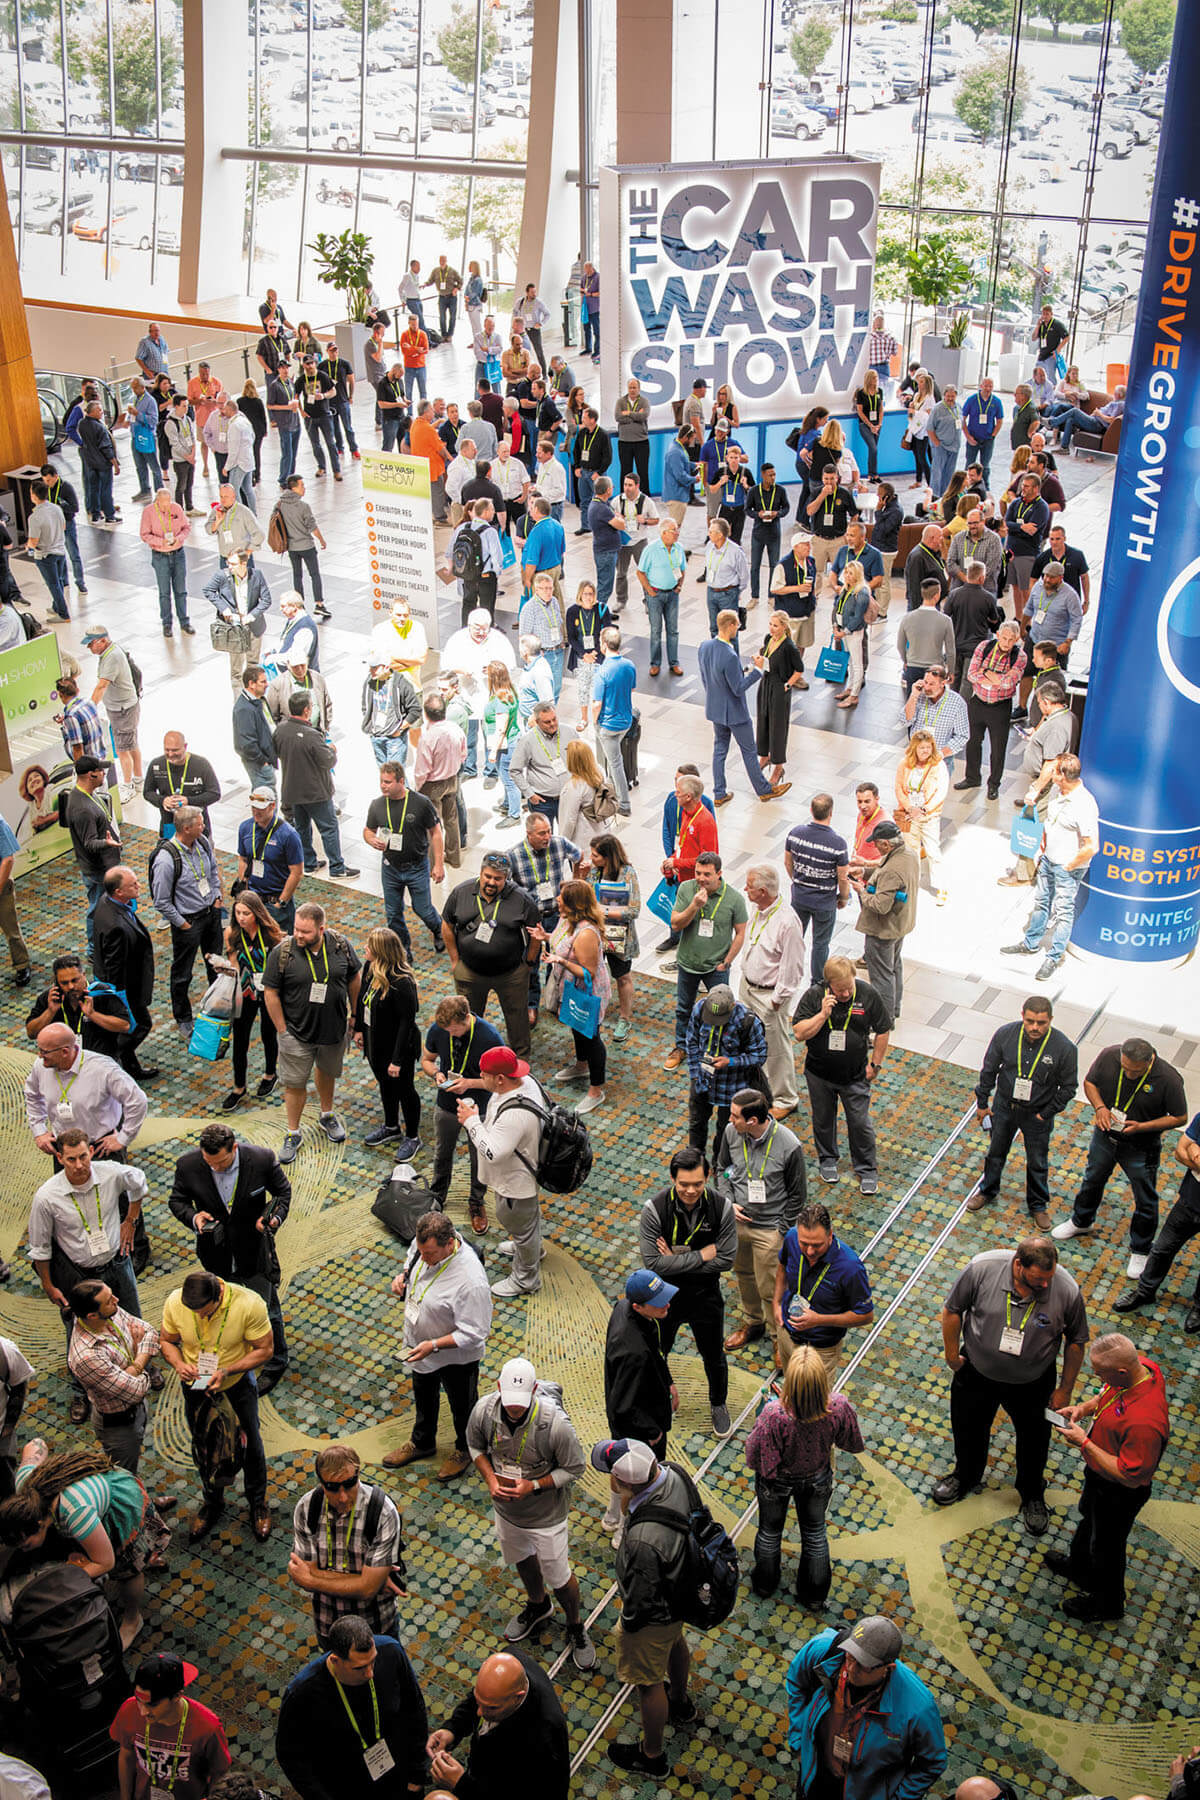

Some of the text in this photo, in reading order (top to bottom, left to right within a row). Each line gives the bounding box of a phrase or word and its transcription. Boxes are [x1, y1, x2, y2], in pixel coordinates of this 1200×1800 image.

[629, 188, 658, 274] THE
[660, 179, 875, 271] CAR
[630, 265, 872, 342] WASH
[630, 332, 868, 406] SHOW
[379, 463, 393, 471] CAR
[395, 465, 415, 474] WASH
[380, 470, 415, 487] SHOW
[375, 504, 412, 518] EXHIBITOR REG
[376, 519, 428, 534] PREMIUM EDUCATION
[377, 534, 427, 550] PEER POWER HOURS
[379, 548, 413, 560] REGISTRATION
[380, 562, 397, 572] IMPACT
[408, 582, 429, 592] THEATER
[1102, 841, 1146, 863] DRB
[1107, 864, 1181, 885] BOOTH
[1124, 907, 1194, 927] UNITEC
[1100, 927, 1172, 947] BOOTH
